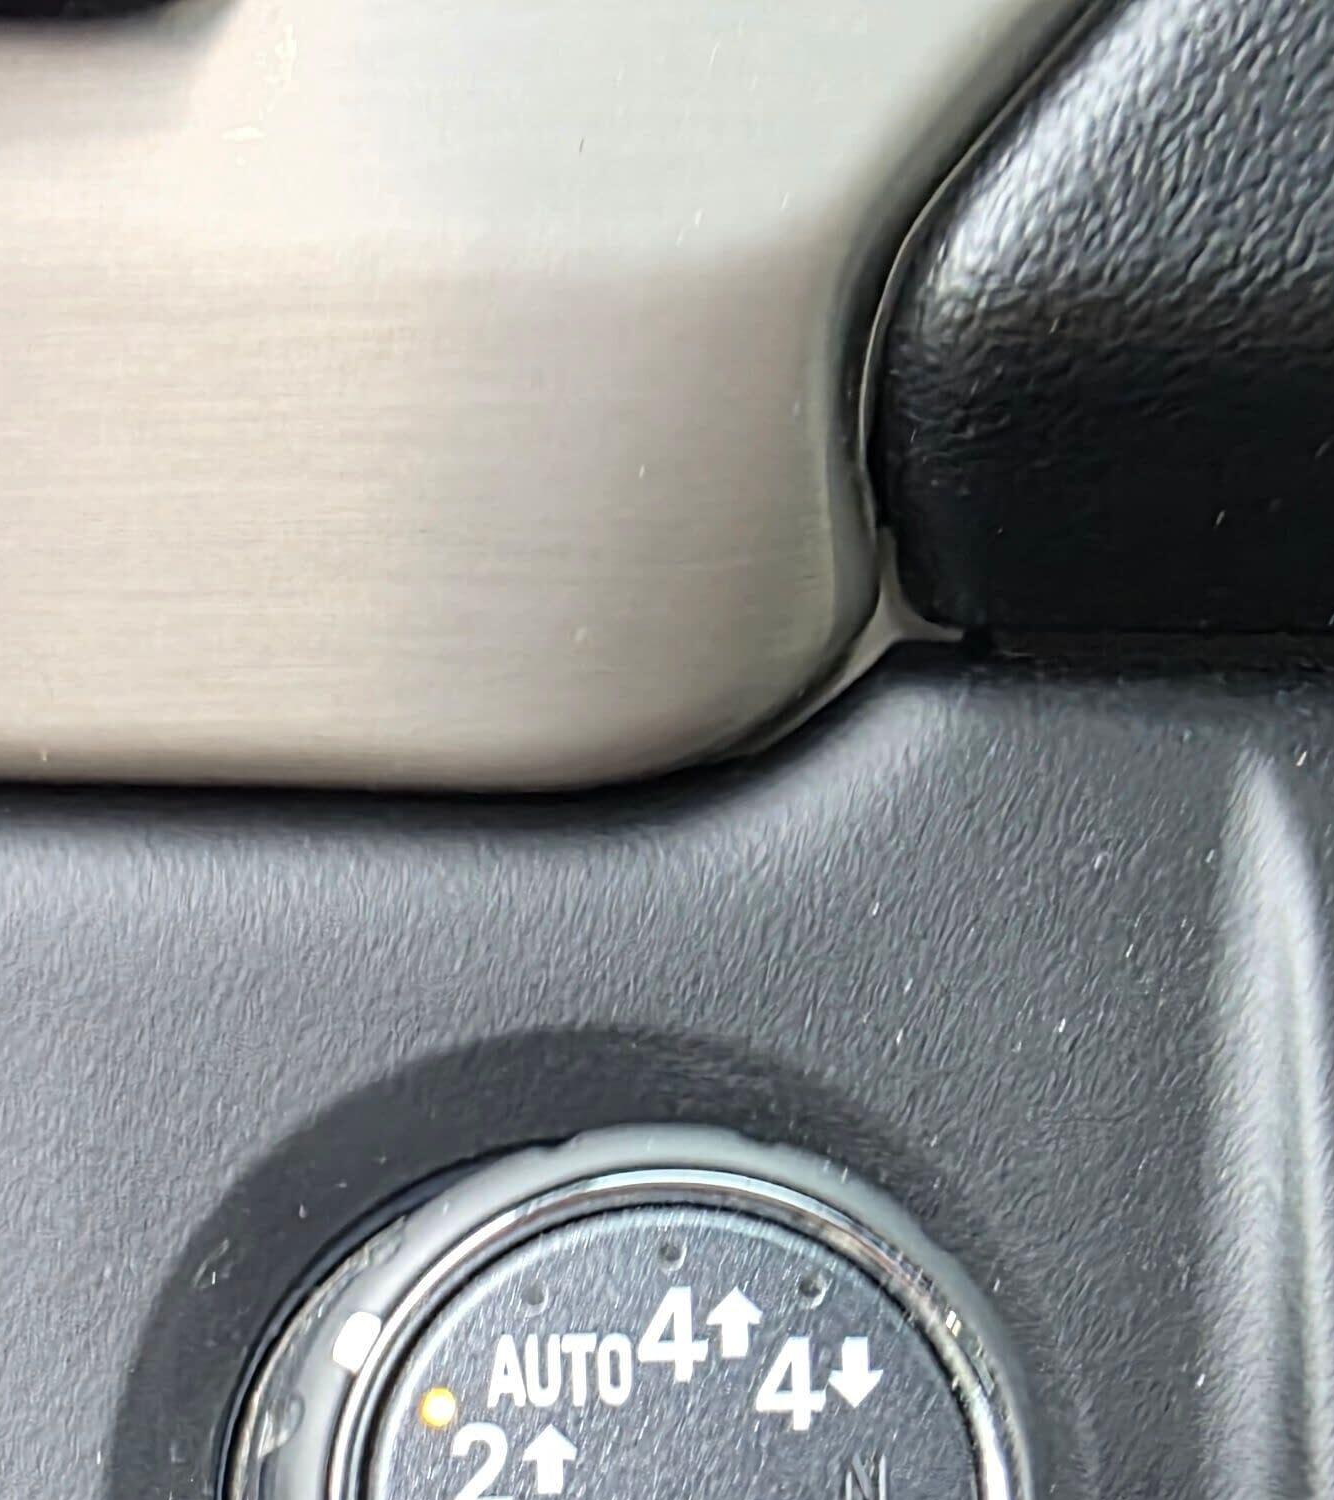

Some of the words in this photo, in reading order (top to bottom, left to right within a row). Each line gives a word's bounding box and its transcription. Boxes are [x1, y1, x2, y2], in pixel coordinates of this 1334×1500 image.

[486, 1332, 634, 1408] AUTO
[637, 1286, 709, 1382] 4
[755, 1336, 827, 1431] 4
